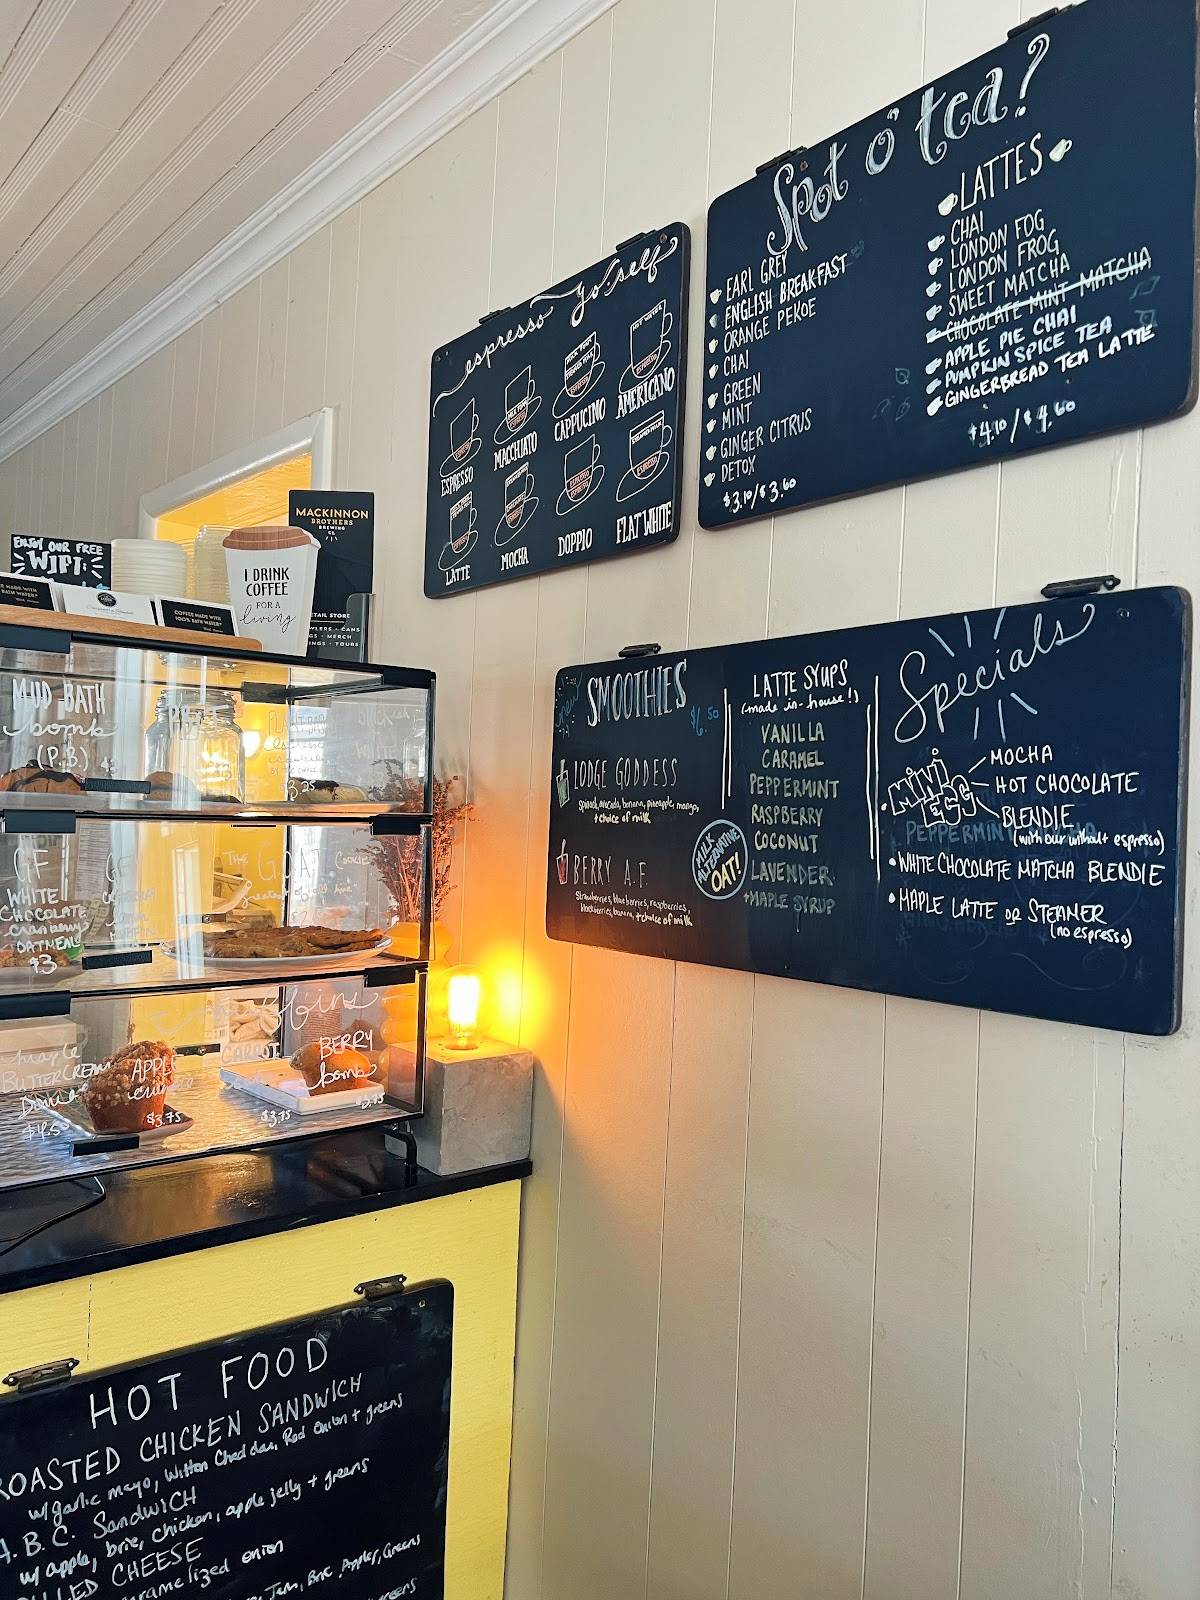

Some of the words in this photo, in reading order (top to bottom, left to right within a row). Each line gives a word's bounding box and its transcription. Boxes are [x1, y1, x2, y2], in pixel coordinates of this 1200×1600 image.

[766, 142, 849, 256] Spot
[915, 33, 1050, 165] tea?
[961, 132, 1042, 211] LATTES
[950, 224, 1008, 269] LONDON
[1015, 209, 1044, 240] FOG
[951, 210, 983, 245] CHAI
[726, 266, 754, 302] EARL
[760, 250, 788, 284] GREY
[949, 250, 1007, 294] LONDON
[1018, 228, 1060, 266] FROG
[725, 288, 772, 330] ENGLISH
[780, 253, 848, 304] BREAKFAST
[948, 280, 996, 317] SWEET
[1004, 253, 1070, 298] MATCHA
[1029, 282, 1069, 314] MINT
[1080, 247, 1152, 296] MATCHA
[724, 316, 770, 354] ORANGE
[778, 298, 816, 330] PEKOE
[945, 338, 990, 370] APPLE
[1000, 328, 1026, 351] PIE
[1032, 305, 1077, 336] CHAI
[455, 306, 553, 385] espresso
[945, 352, 1010, 389] PUMPKIN
[1014, 332, 1066, 363] SPICE
[1075, 316, 1112, 344] TEA
[724, 350, 749, 376] CHAI
[944, 362, 1049, 408] GINGERBREAD
[1054, 349, 1089, 372] TEA
[1098, 324, 1156, 359] LATTE
[616, 366, 675, 420] AMERICANO
[724, 372, 761, 406] GREEN
[555, 397, 606, 441] CAPPUCINO
[720, 426, 764, 458] GINGER
[770, 408, 812, 442] CITRUS
[722, 402, 752, 430] MINT
[494, 431, 538, 471] MACCHIATO
[441, 466, 474, 496] ESPRESSO
[722, 455, 756, 482] DETOX
[296, 508, 369, 519] MACKINNON
[311, 518, 353, 526] BROTHERS
[616, 511, 642, 544] FLAT
[642, 501, 672, 536] WHITE
[13, 536, 44, 550] ENJOY
[48, 541, 70, 552] OUR
[76, 543, 104, 556] FREE
[500, 546, 530, 571] MOCHA
[558, 528, 592, 556] DOPPIO
[244, 568, 248, 582] I
[254, 568, 290, 582] DRINK
[246, 582, 288, 596] COFFEE
[446, 565, 471, 586] LATTE
[240, 604, 296, 633] living
[754, 672, 797, 698] LATTE
[804, 659, 848, 690] SYUPS
[895, 604, 1095, 742] Specials
[12, 678, 51, 712] MUD
[64, 682, 106, 714] BATH
[587, 658, 687, 726] SMOOTHIES
[741, 701, 778, 714] (made
[762, 721, 824, 744] VANILLA
[762, 749, 824, 770] CARAMEL
[990, 745, 1053, 765] MOCHA
[574, 760, 608, 790] LODGE
[616, 757, 678, 790] GODDESS
[750, 773, 839, 799] PEPPERMINT
[996, 776, 1028, 794] HOT
[1036, 772, 1140, 794] CHOCOLATE
[752, 804, 823, 827] RASPBERRY
[1002, 804, 1075, 830] BLENDIE
[696, 832, 714, 868] MILK
[754, 830, 818, 853] COCONUT
[1069, 828, 1108, 846] without
[1114, 830, 1164, 855] espresso)
[574, 854, 612, 885] BERRY
[712, 852, 741, 892] OAT!
[898, 851, 934, 875] WHITE
[938, 852, 1012, 882] CHOCOLATE
[1018, 858, 1074, 881] MATCHA
[1088, 861, 1166, 886] BLENDIE
[0, 904, 86, 922] CHOCOLATE
[7, 888, 58, 907] WHITE
[793, 894, 836, 914] SYRUP
[900, 888, 944, 914] MAPLE
[952, 897, 998, 920] LATTE
[1028, 898, 1107, 924] STEAMER
[1050, 924, 1070, 938] (no
[1074, 926, 1132, 949] espresso)
[320, 1030, 372, 1060] BERRY
[146, 1112, 182, 1128] $3.75
[89, 1372, 182, 1430] HOT
[221, 1337, 328, 1399] FOOD
[140, 1410, 241, 1462] CHICKEN
[258, 1373, 363, 1434] SANDWICH
[282, 1428, 306, 1446] Red
[352, 1408, 360, 1422] +
[366, 1393, 403, 1425] greens
[46, 1550, 97, 1578] apple,
[106, 1537, 144, 1558] brie,
[226, 1492, 264, 1518] apple
[270, 1479, 301, 1508] jelly
[308, 1474, 318, 1487] +
[324, 1458, 370, 1491] greens
[112, 1537, 204, 1586] CHEESE
[242, 1540, 284, 1564] onion
